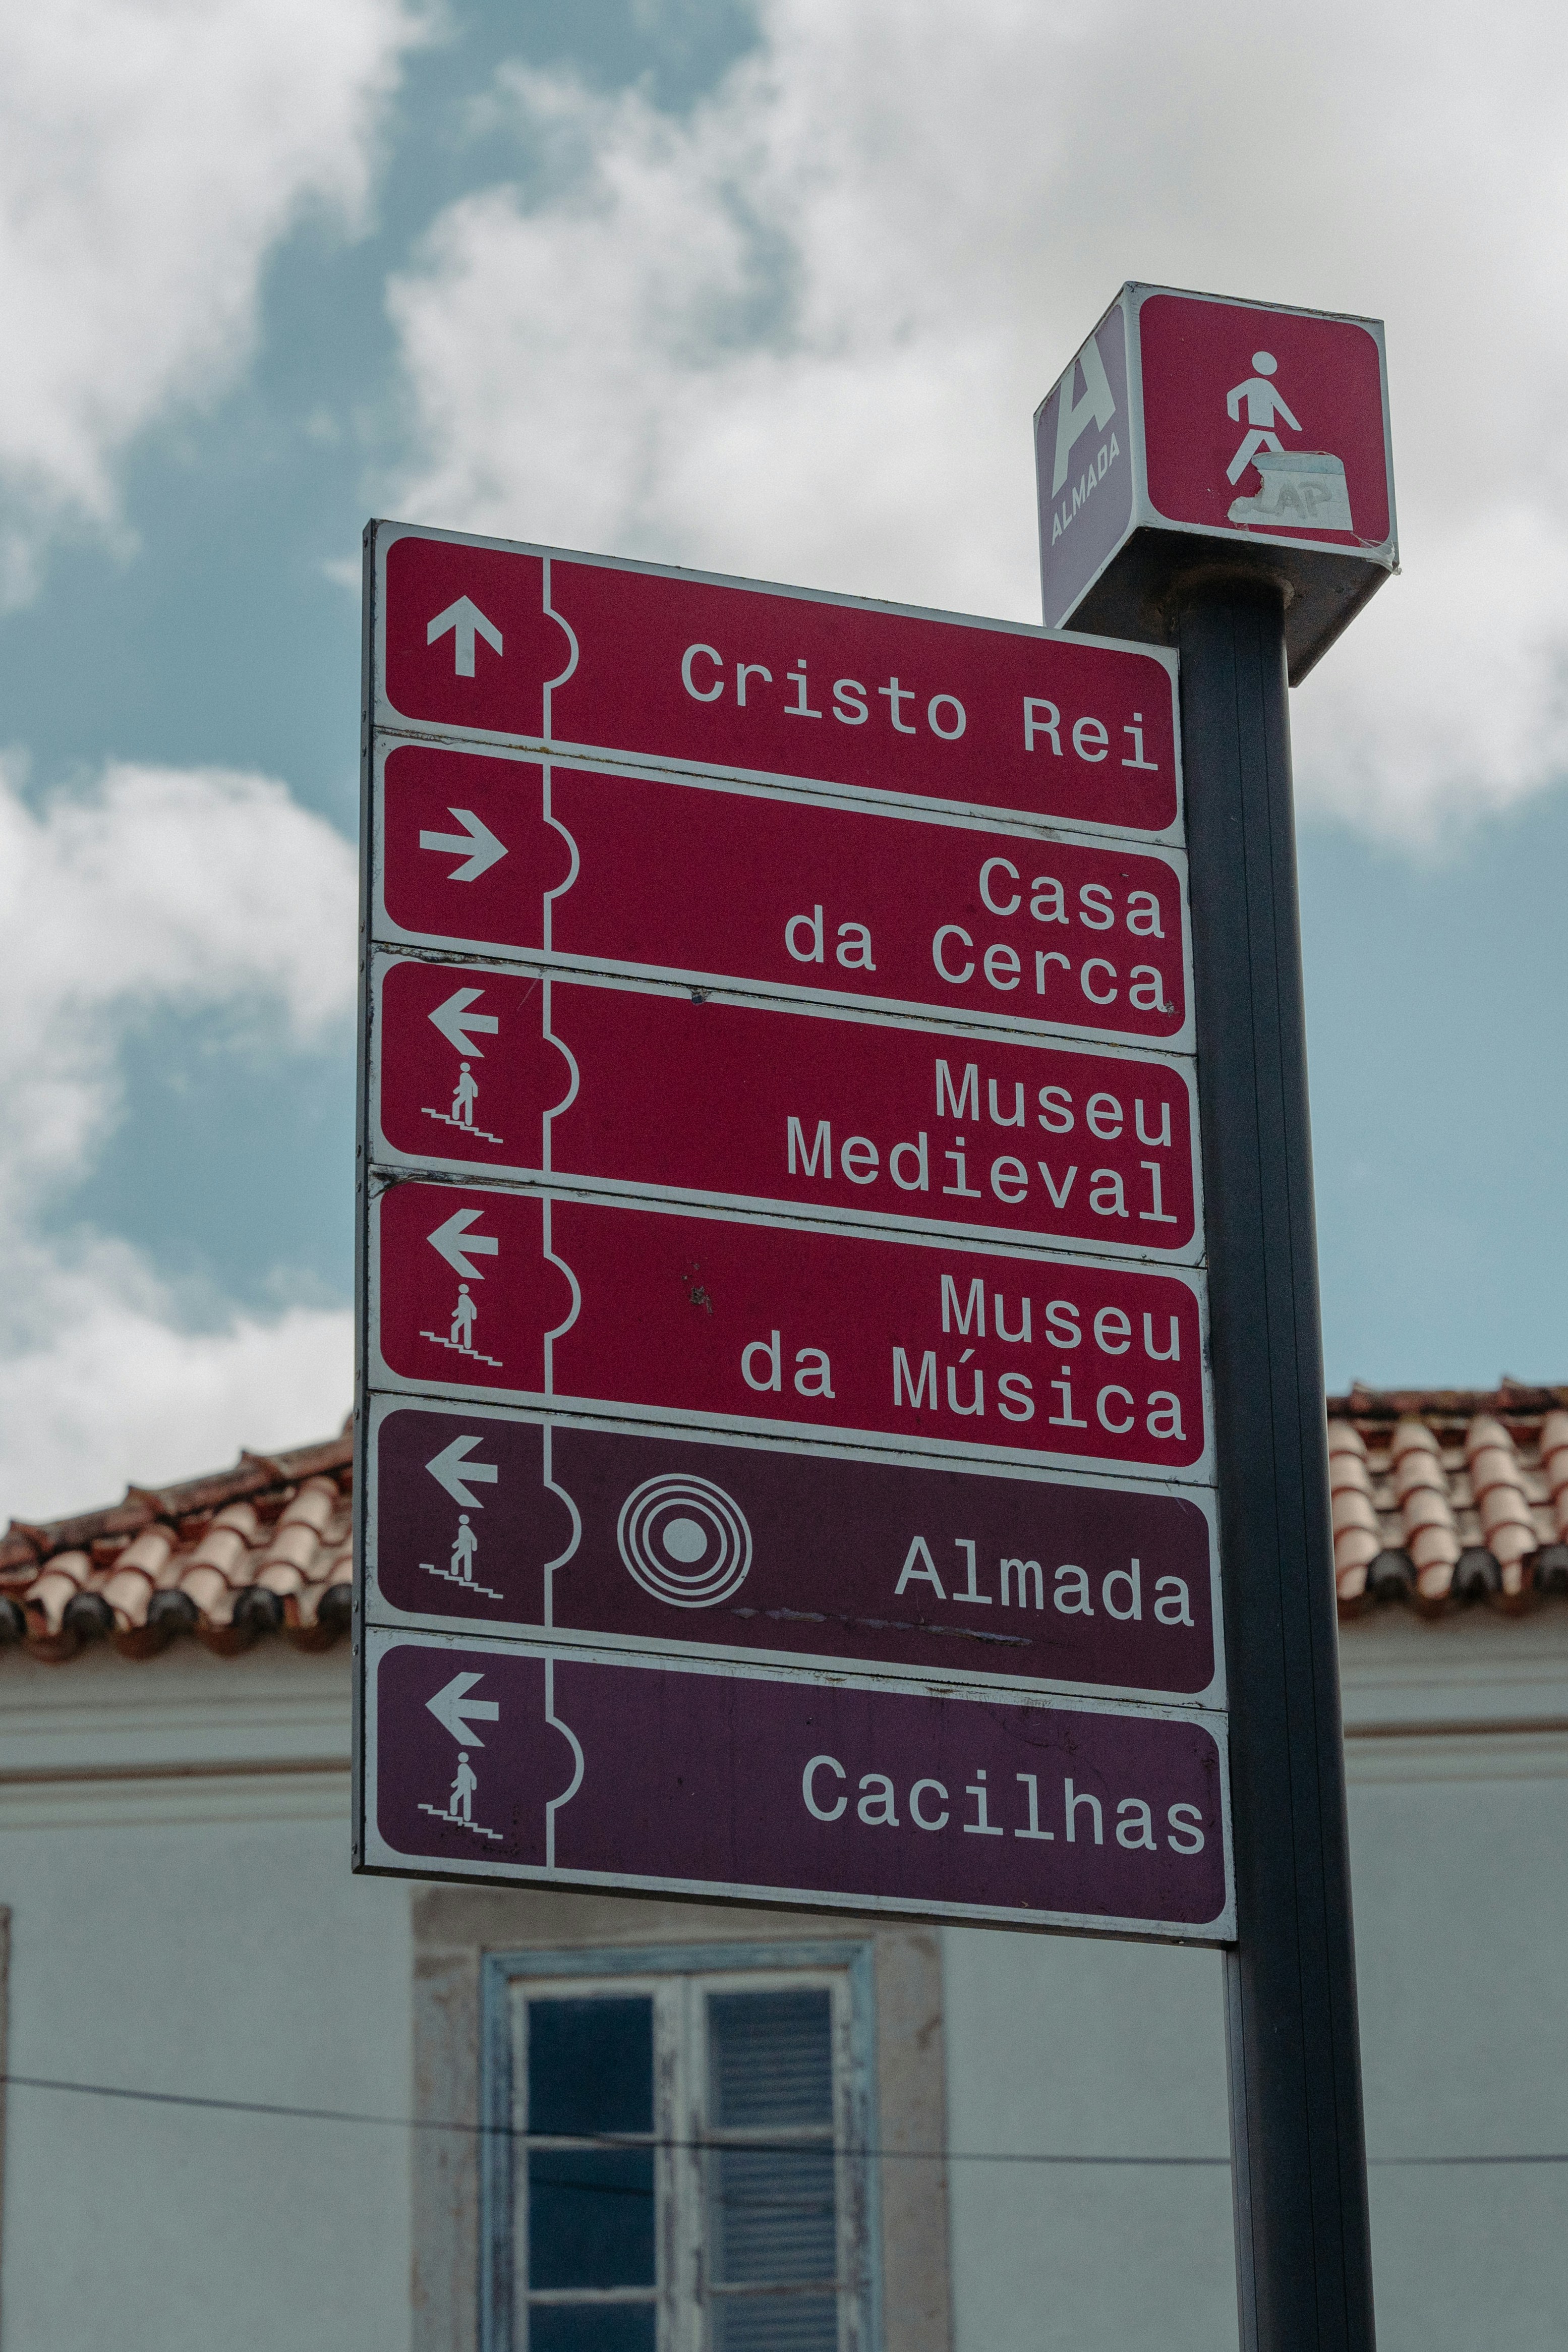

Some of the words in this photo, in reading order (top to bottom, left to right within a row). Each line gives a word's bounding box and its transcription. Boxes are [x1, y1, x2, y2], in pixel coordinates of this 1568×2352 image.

[1052, 431, 1120, 547] ALMADA
[680, 643, 967, 740] Cristo
[1023, 696, 1159, 771] Rei
[978, 856, 1166, 939] Casa
[784, 903, 877, 971] da
[932, 924, 1169, 1013] Cerca
[935, 1058, 1172, 1148] Museu
[787, 1115, 1178, 1224] Medieval
[940, 1274, 1181, 1362] Museu
[740, 1329, 836, 1399] da
[892, 1346, 1187, 1441] Música
[894, 1535, 1195, 1627] Almada
[801, 1754, 1205, 1855] Cacilhas
